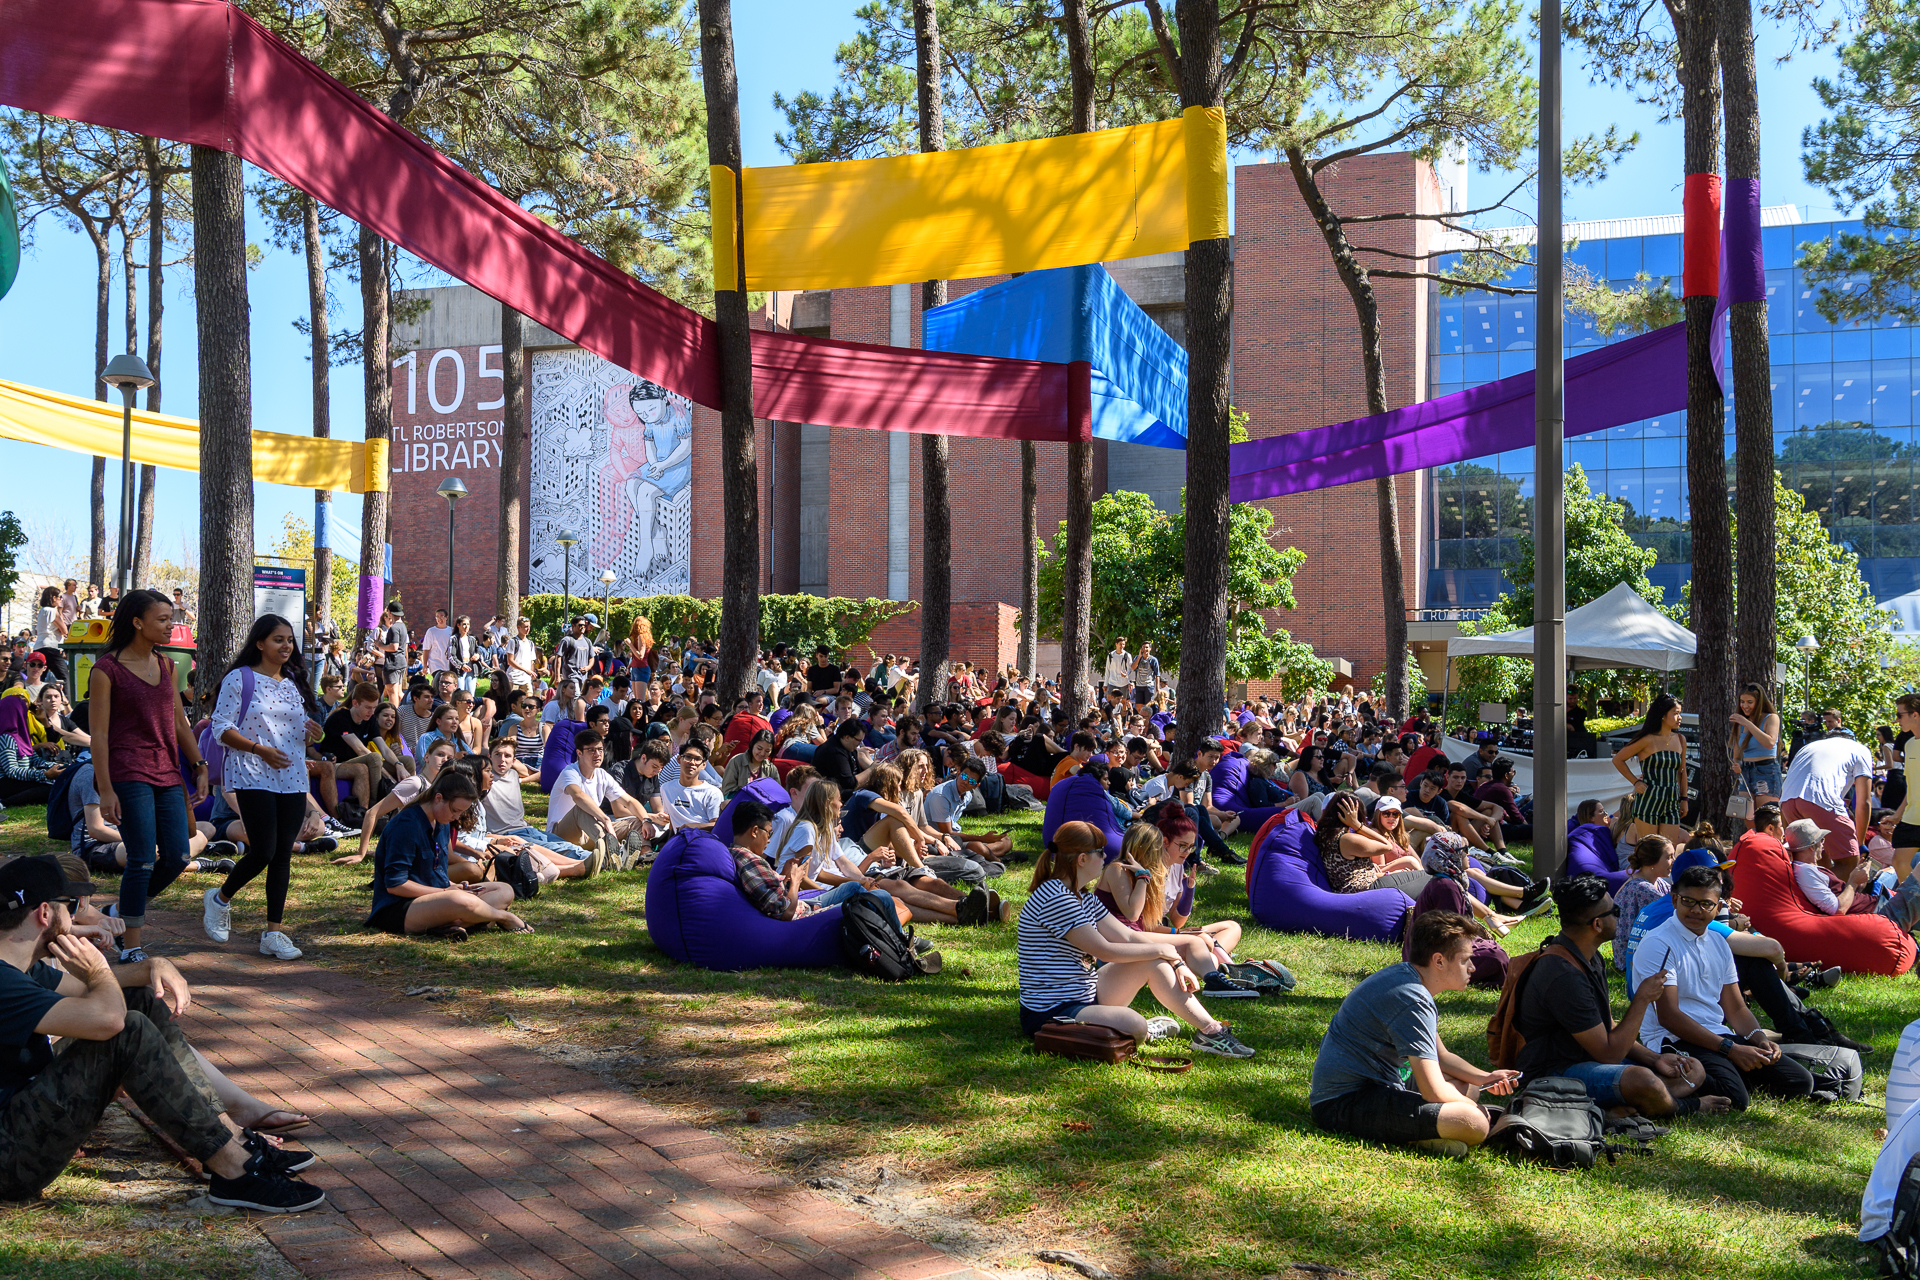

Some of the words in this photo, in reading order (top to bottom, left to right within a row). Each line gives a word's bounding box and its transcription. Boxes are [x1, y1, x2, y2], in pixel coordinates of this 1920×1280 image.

[392, 345, 505, 415] 105
[392, 426, 409, 442] TL
[392, 439, 504, 473] IBRARY
